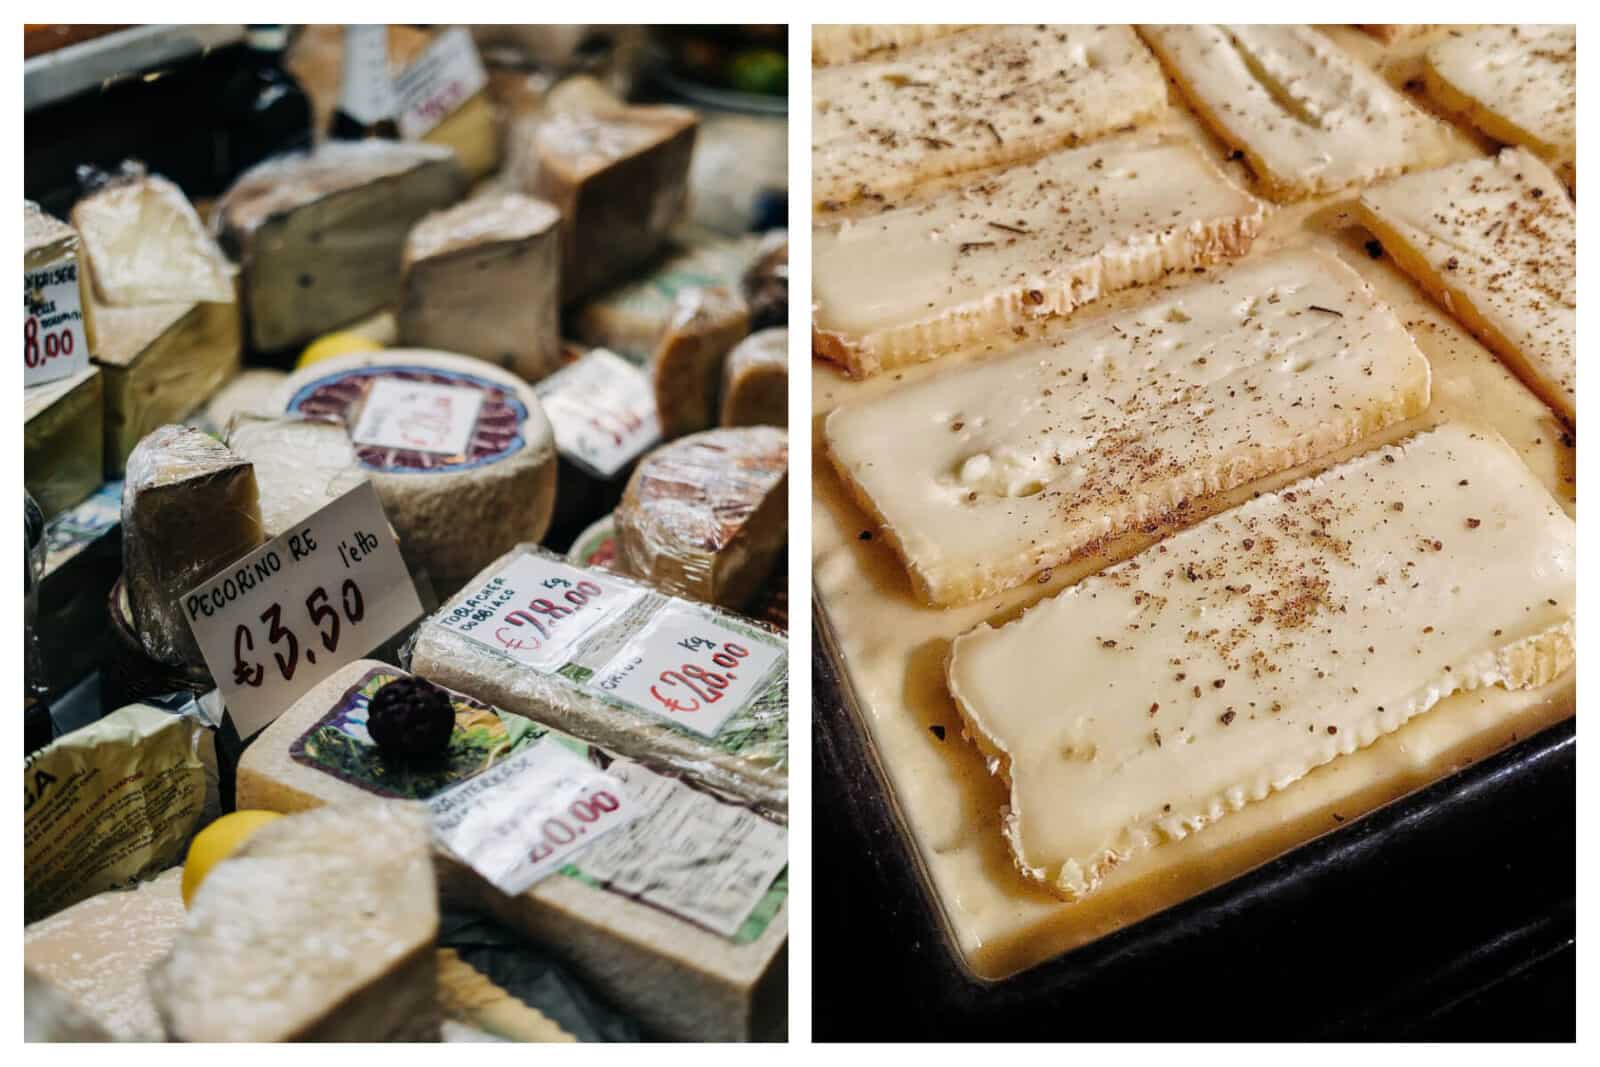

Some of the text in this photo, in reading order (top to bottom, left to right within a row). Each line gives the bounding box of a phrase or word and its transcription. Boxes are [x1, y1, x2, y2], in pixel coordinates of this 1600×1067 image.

[288, 528, 317, 562] RE
[440, 576, 506, 626] TOBLACHER
[677, 634, 717, 652] Kg
